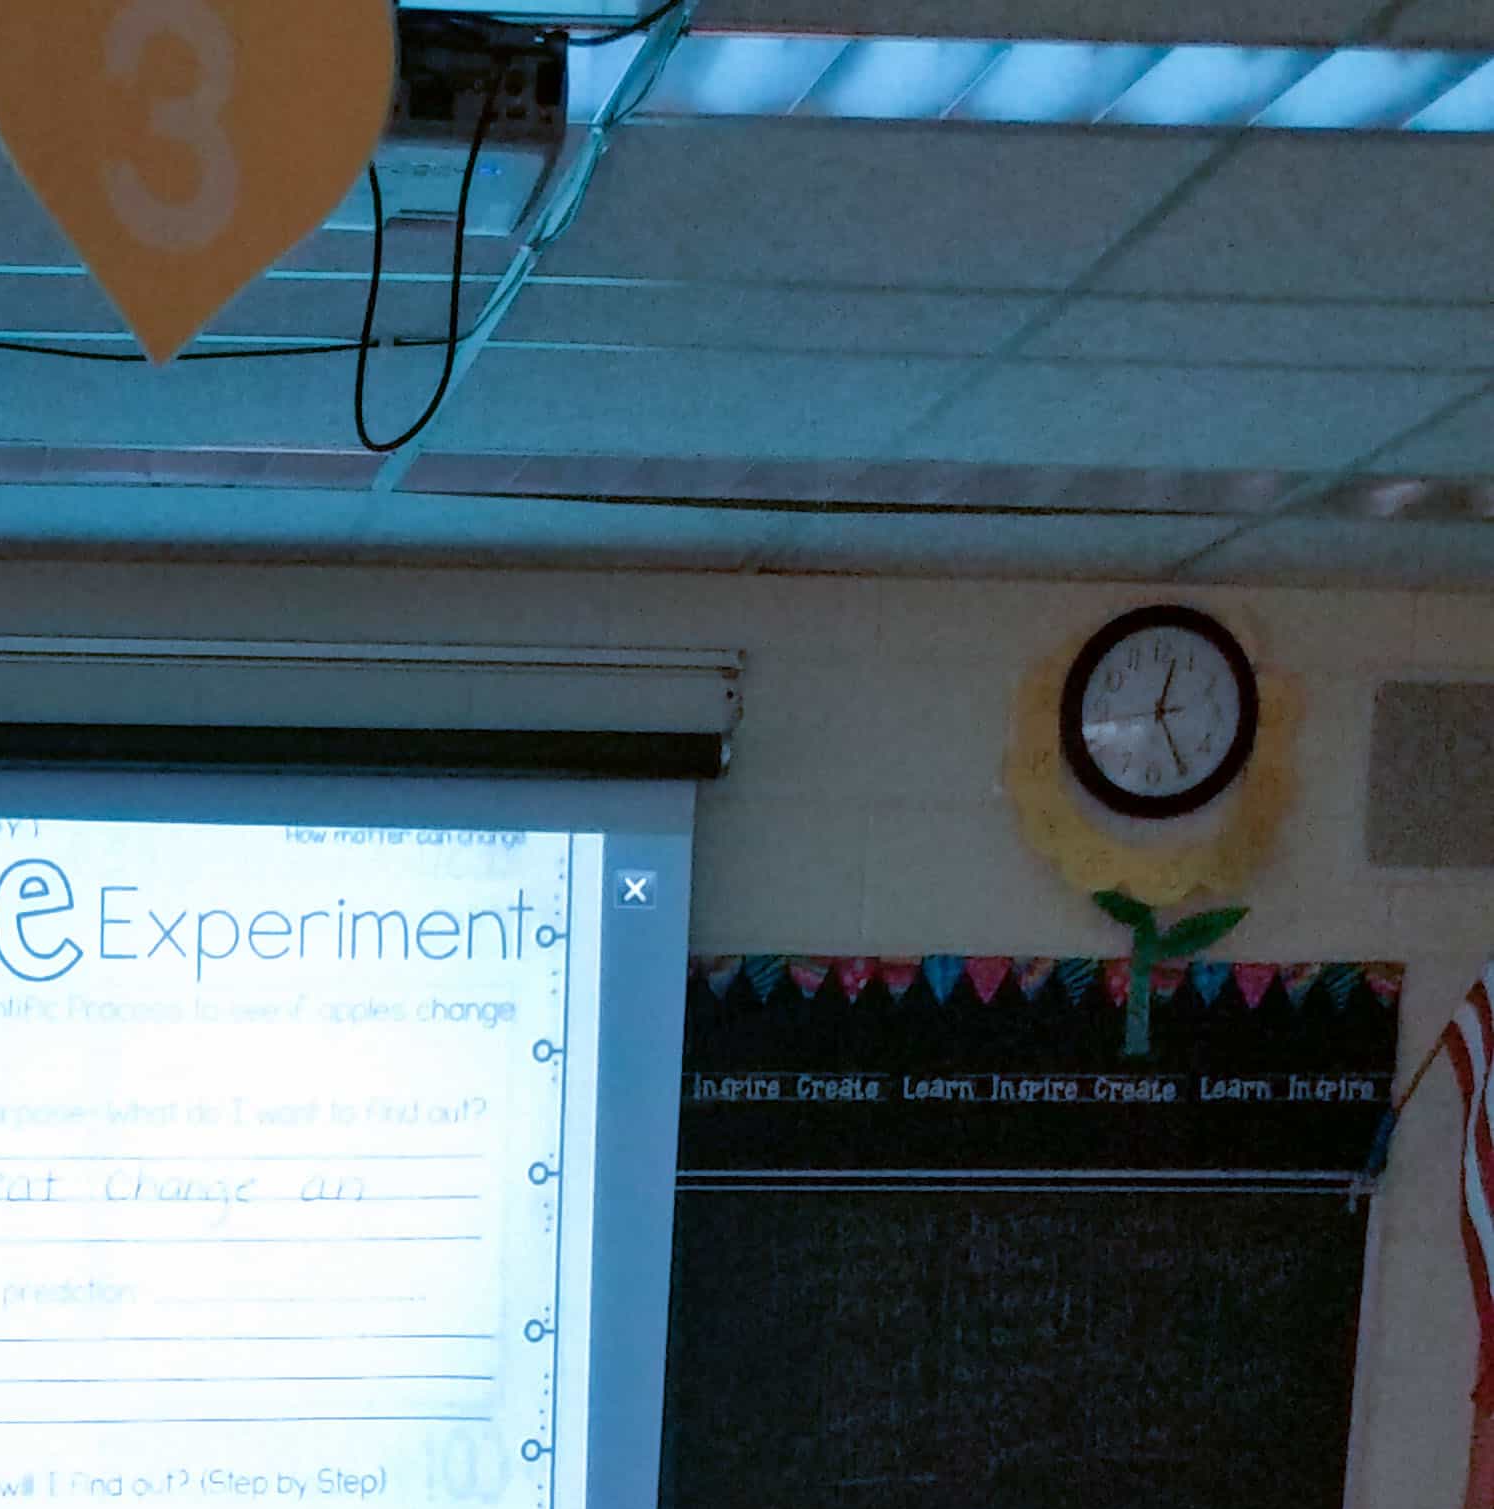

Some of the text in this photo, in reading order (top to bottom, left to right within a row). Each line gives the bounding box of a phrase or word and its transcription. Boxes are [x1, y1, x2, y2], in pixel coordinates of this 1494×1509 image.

[103, 0, 236, 250] 3
[98, 885, 535, 985] Experiment
[414, 998, 517, 1029] change
[795, 1073, 881, 1101] Create
[902, 1074, 976, 1101] Learn
[1092, 1074, 1178, 1102] Create
[1199, 1075, 1274, 1102] Learn
[297, 1172, 368, 1204] an
[131, 1467, 190, 1497] out?
[199, 1467, 267, 1500] (Step
[275, 1467, 308, 1501] by
[316, 1465, 388, 1502] Step)
